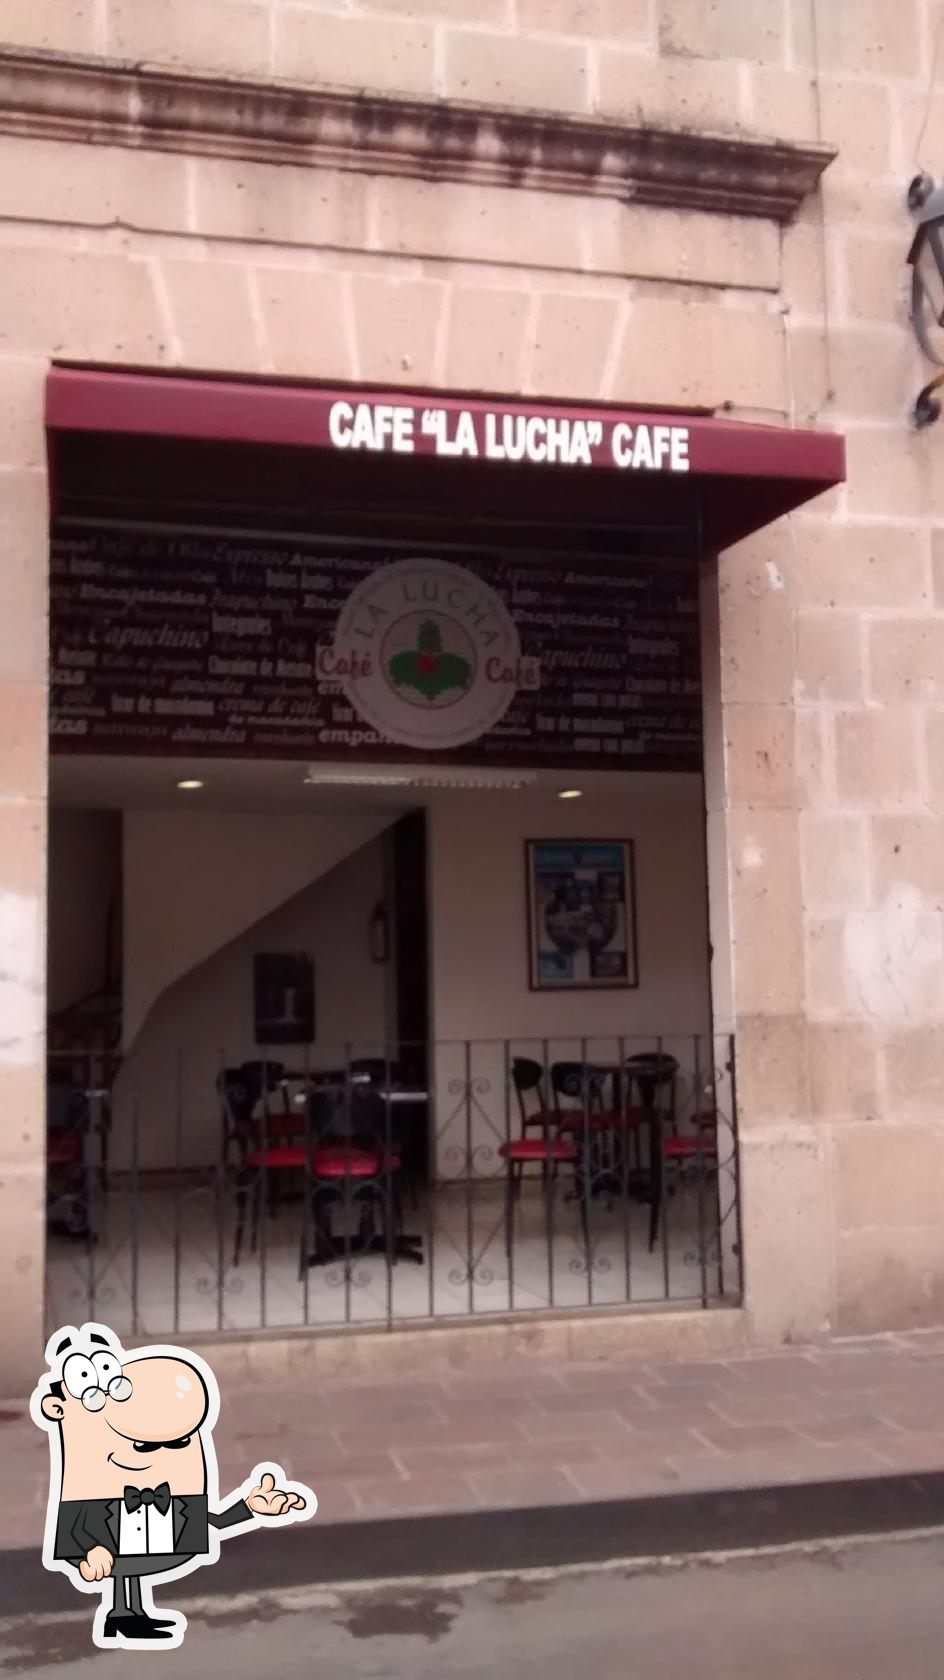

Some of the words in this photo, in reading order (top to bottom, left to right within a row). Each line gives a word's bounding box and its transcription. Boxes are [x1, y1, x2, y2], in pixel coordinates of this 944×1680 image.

[329, 401, 414, 452] CAFE
[611, 423, 690, 472] CAFE
[353, 602, 388, 640] LA
[402, 580, 500, 648] LUCHA
[318, 648, 374, 681] Café
[486, 655, 537, 687] Café
